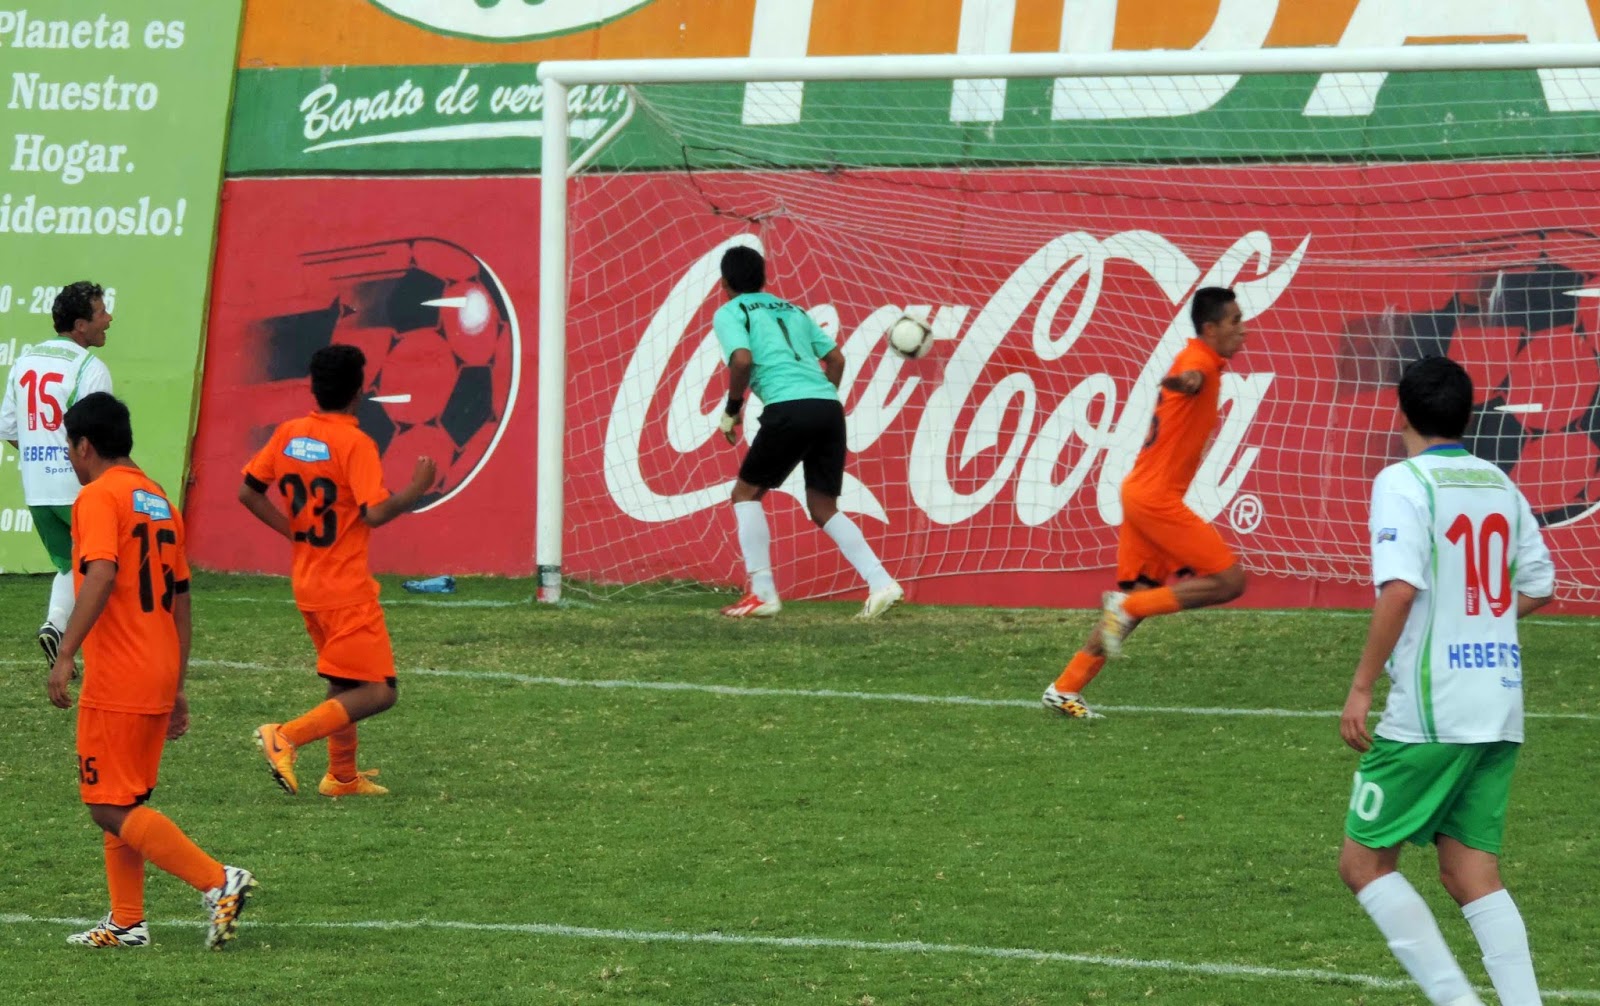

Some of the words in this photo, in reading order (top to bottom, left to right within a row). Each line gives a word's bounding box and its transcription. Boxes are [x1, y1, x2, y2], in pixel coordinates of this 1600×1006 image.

[144, 19, 185, 48] es
[8, 73, 158, 110] Nuestro
[301, 79, 424, 140] Barato
[436, 69, 479, 115] de
[10, 134, 135, 184] Hogar.
[777, 317, 801, 361] 1
[20, 369, 64, 431] 15
[279, 473, 337, 548] 23
[132, 523, 176, 613] 15
[1445, 513, 1511, 617] 10
